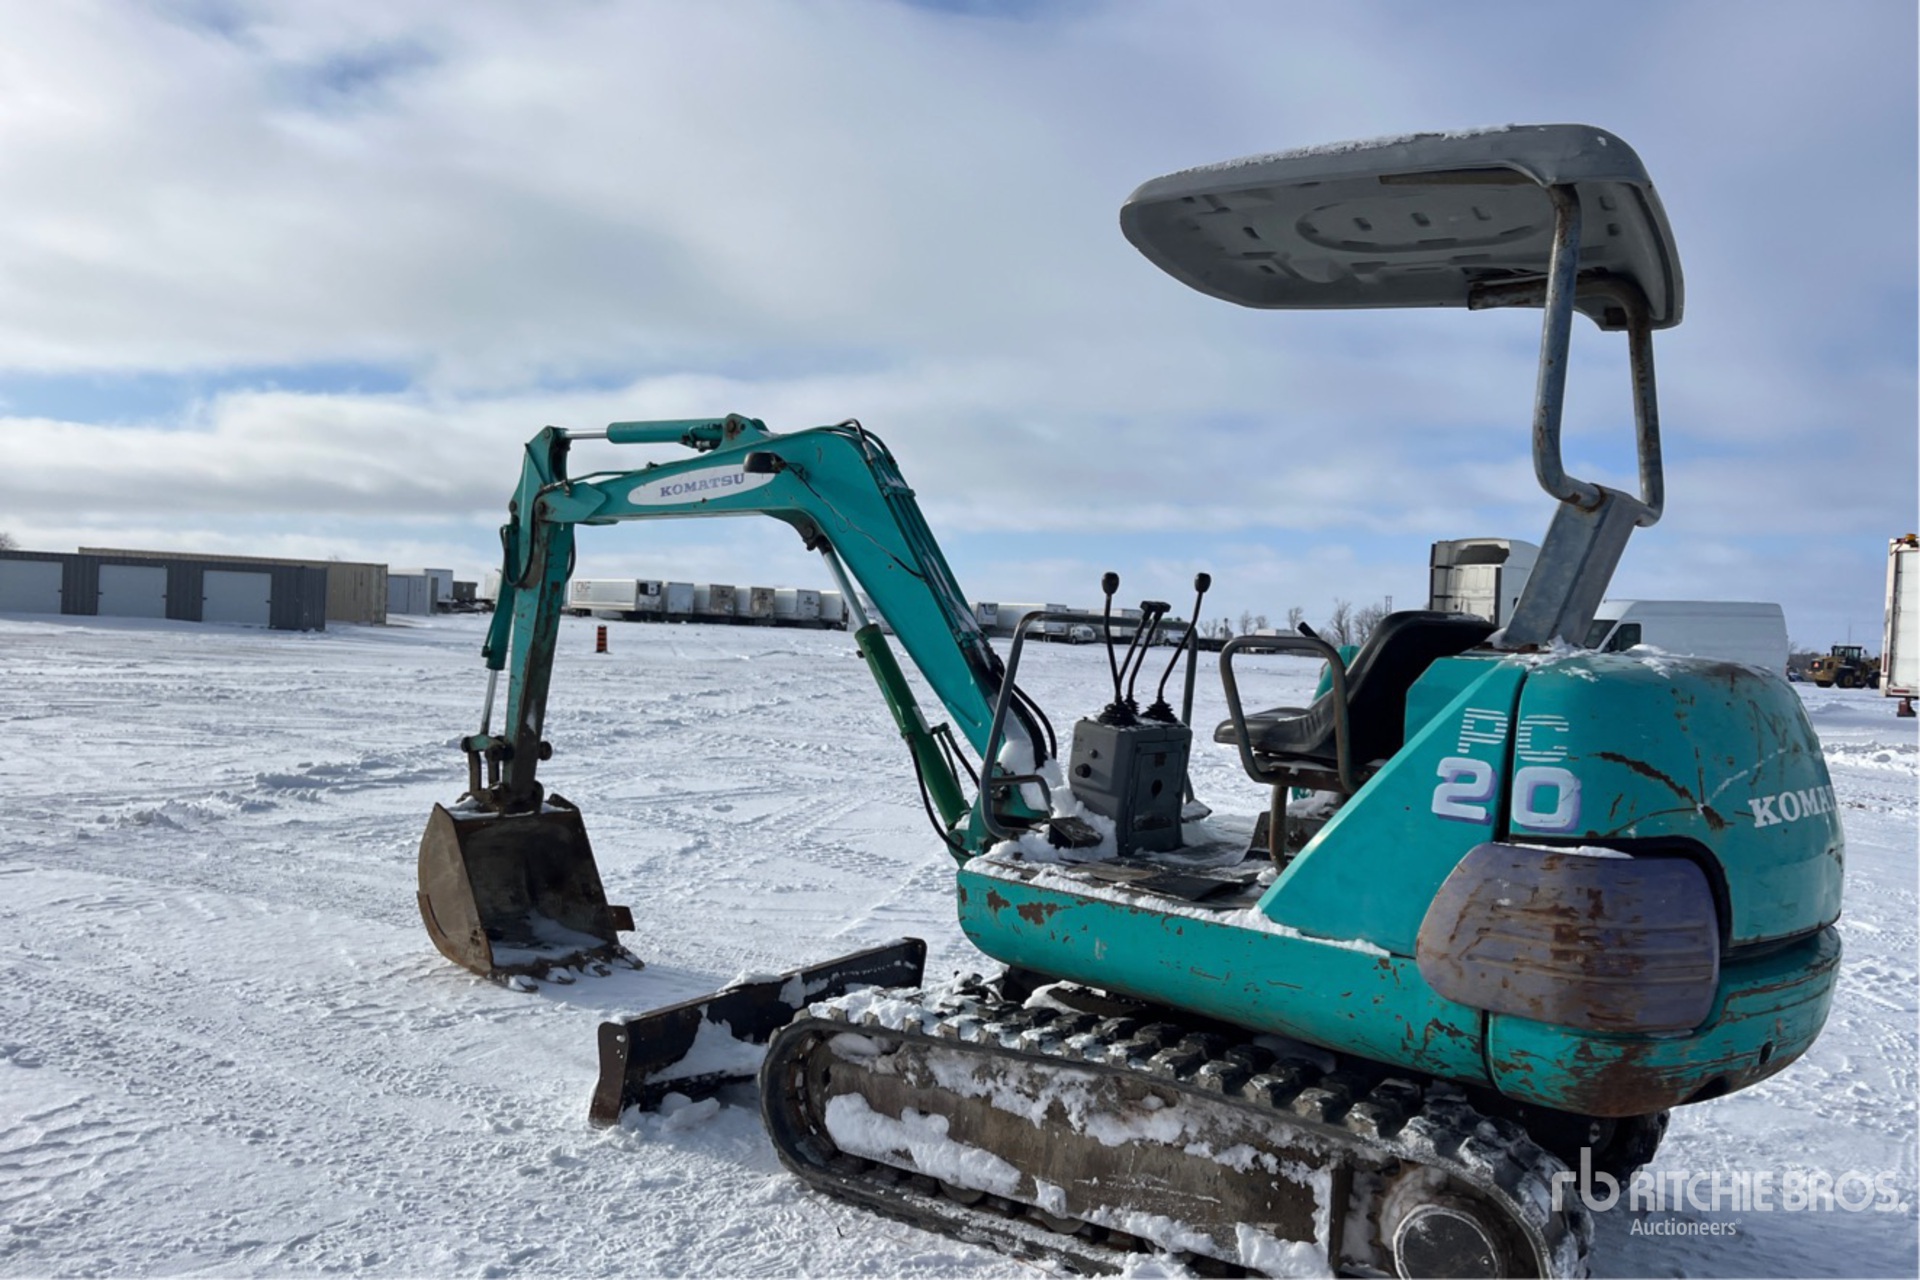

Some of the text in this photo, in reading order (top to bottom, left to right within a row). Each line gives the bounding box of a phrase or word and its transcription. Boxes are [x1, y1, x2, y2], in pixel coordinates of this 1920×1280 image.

[660, 472, 746, 498] KOMATSU
[1456, 707, 1570, 763] PC
[1431, 756, 1582, 831] 20
